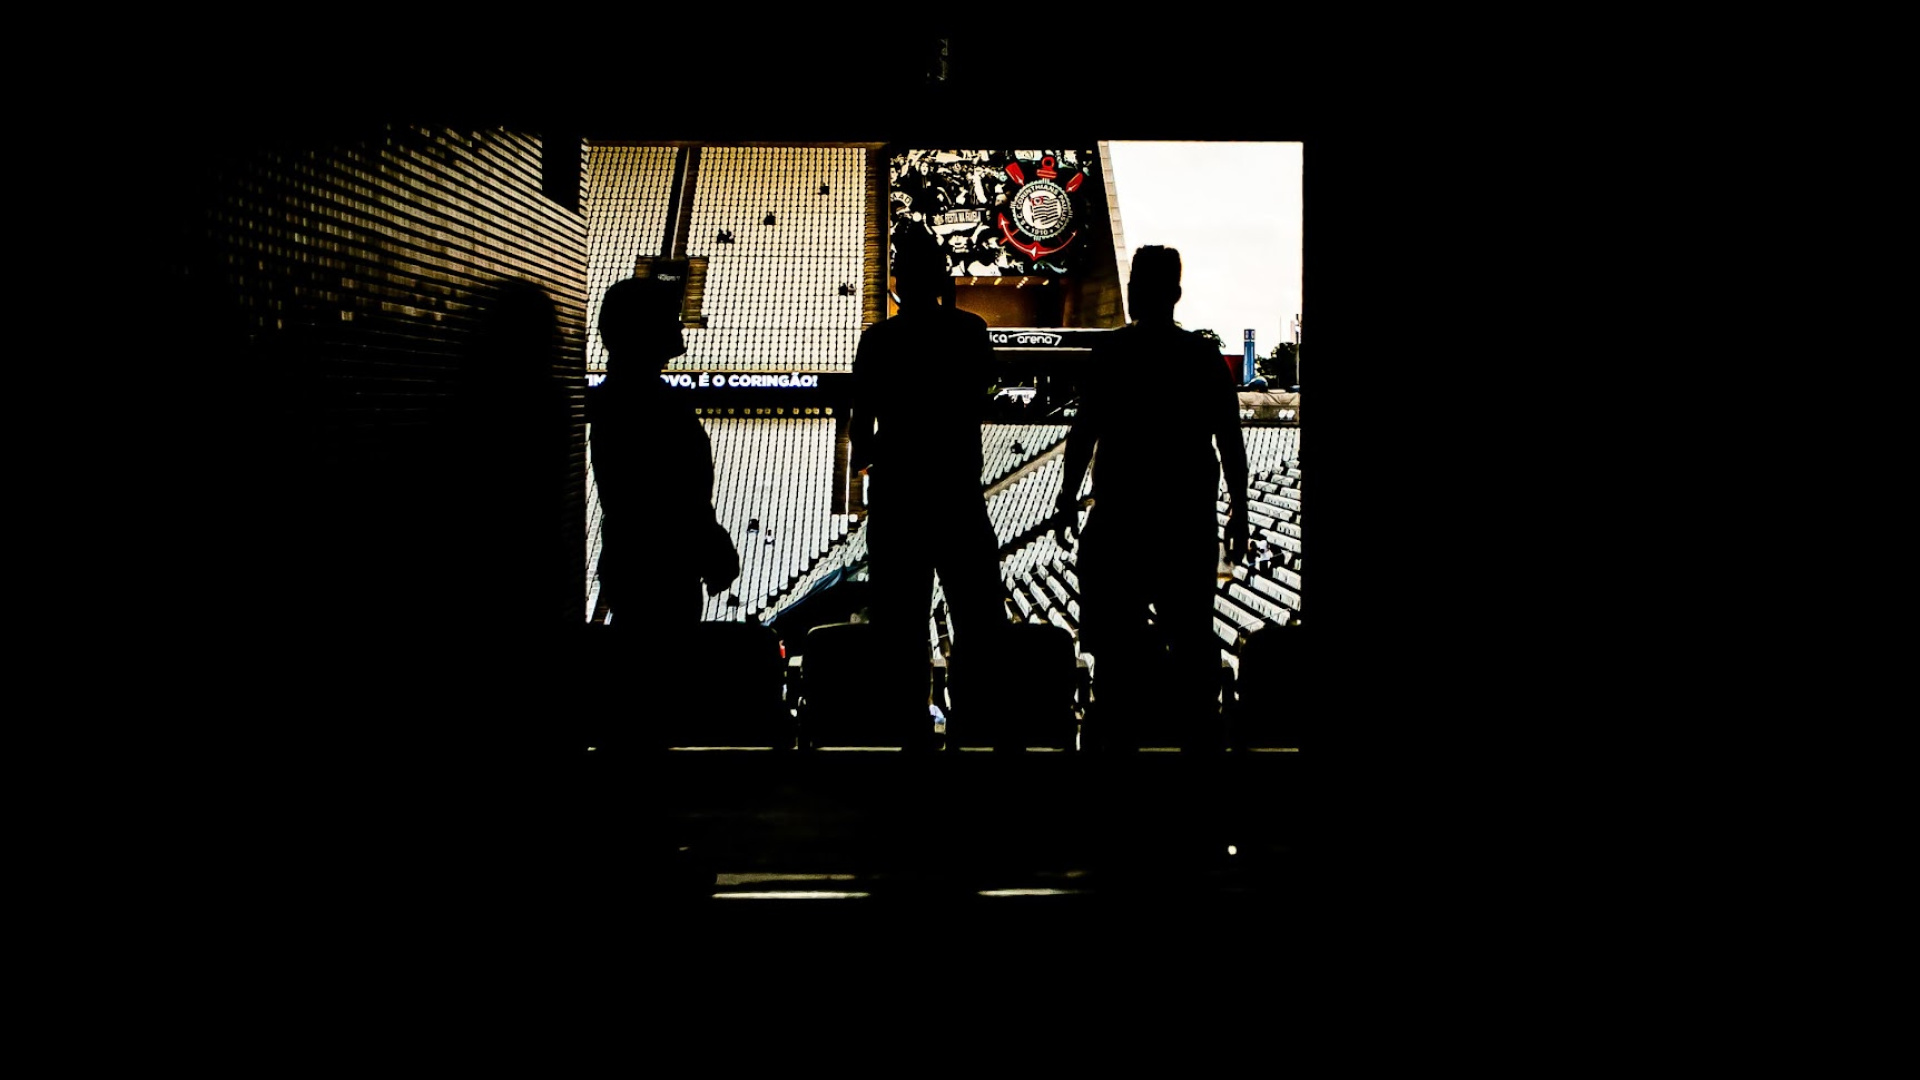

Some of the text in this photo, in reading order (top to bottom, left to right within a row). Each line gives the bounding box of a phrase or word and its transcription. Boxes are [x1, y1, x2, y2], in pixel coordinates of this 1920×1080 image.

[1016, 184, 1059, 210] CORINTHIANS
[1054, 194, 1068, 229] PAULISTA
[1031, 228, 1049, 236] 1910
[1017, 335, 1053, 345] arena
[698, 371, 710, 387] É
[712, 374, 726, 387] O
[728, 371, 818, 388] CORINGÃO!
